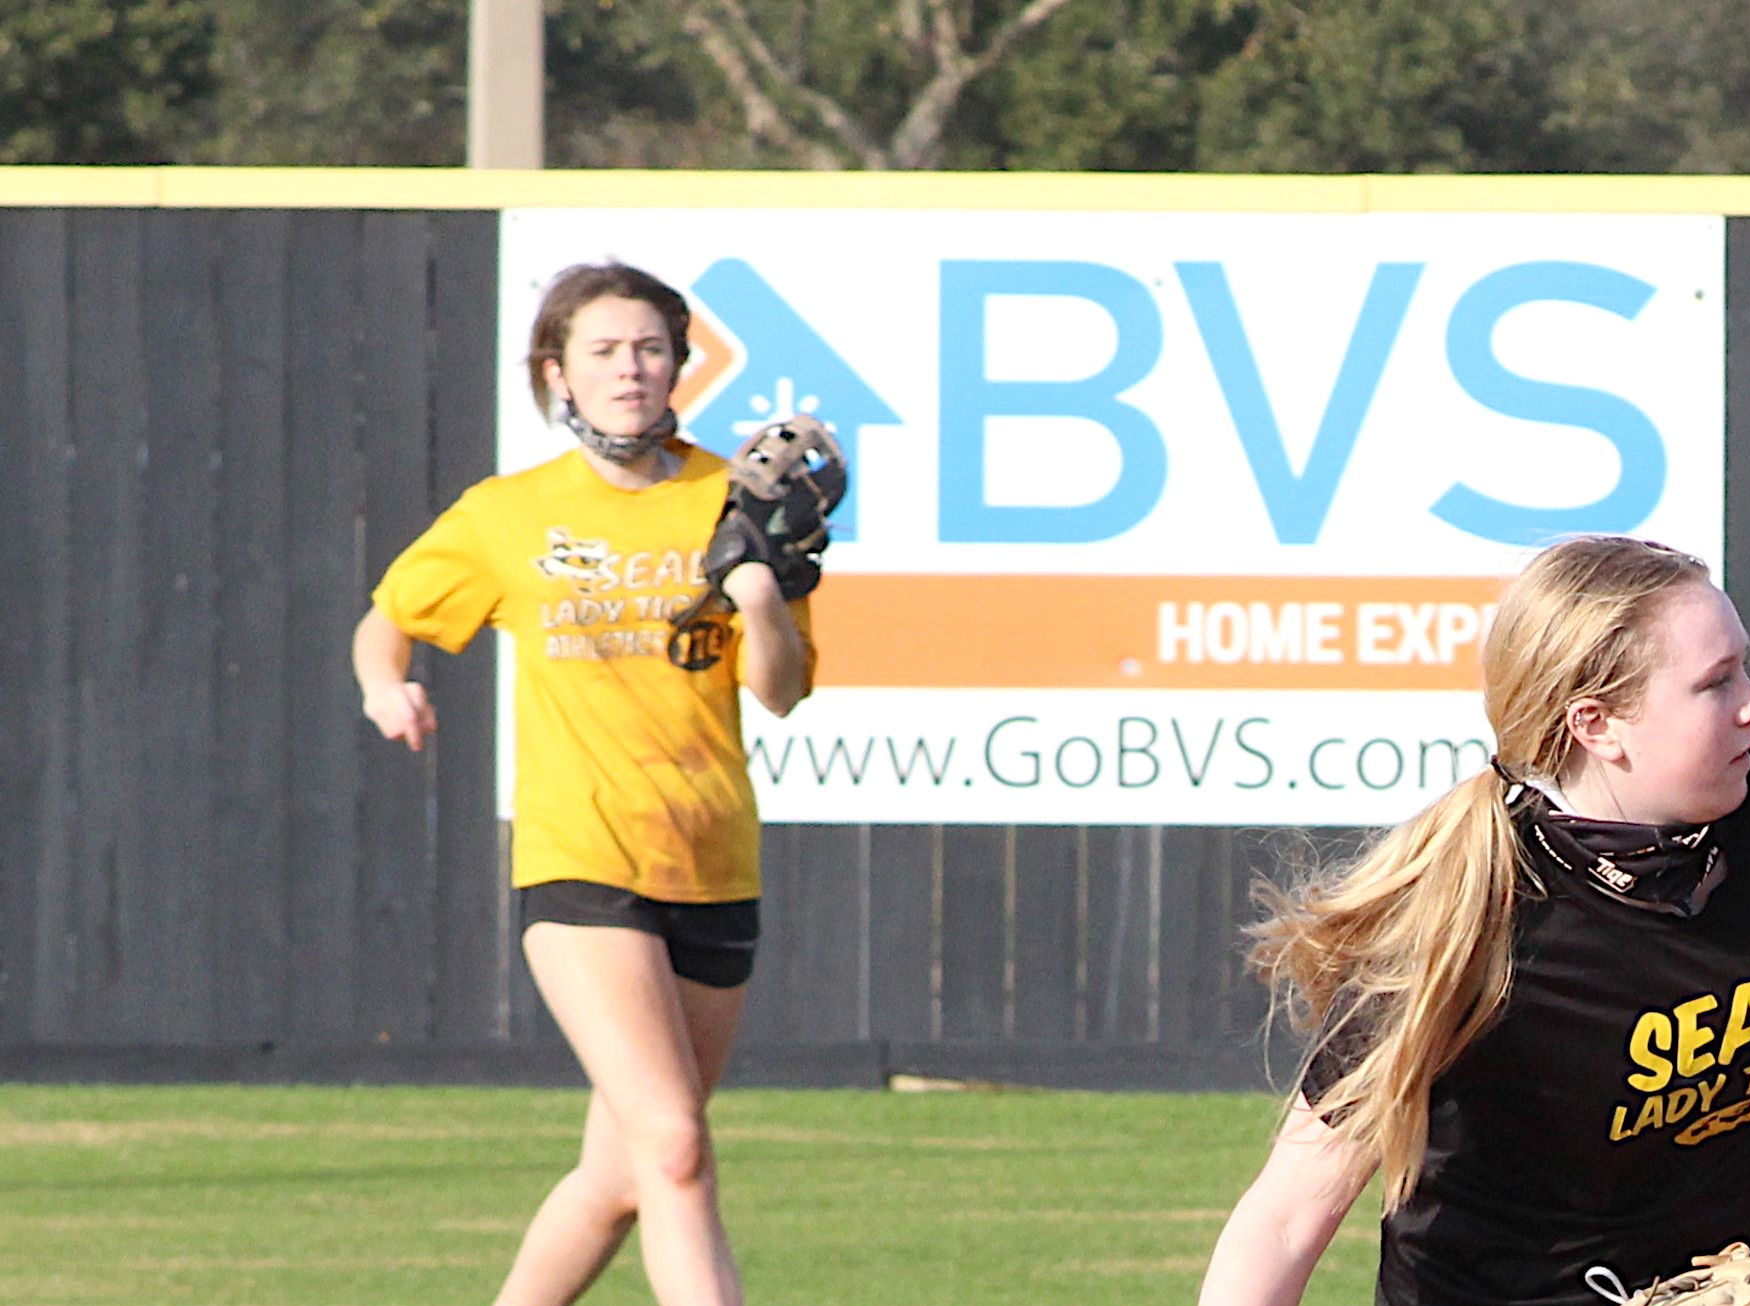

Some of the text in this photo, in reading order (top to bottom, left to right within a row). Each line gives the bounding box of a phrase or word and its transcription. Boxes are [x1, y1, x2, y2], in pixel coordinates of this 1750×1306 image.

[938, 259, 1668, 548] BVS
[600, 549, 709, 593] SEAL
[541, 594, 693, 631] LADY TIG
[1158, 602, 1495, 665] HOME EXP
[1609, 1072, 1727, 1142] LADY
